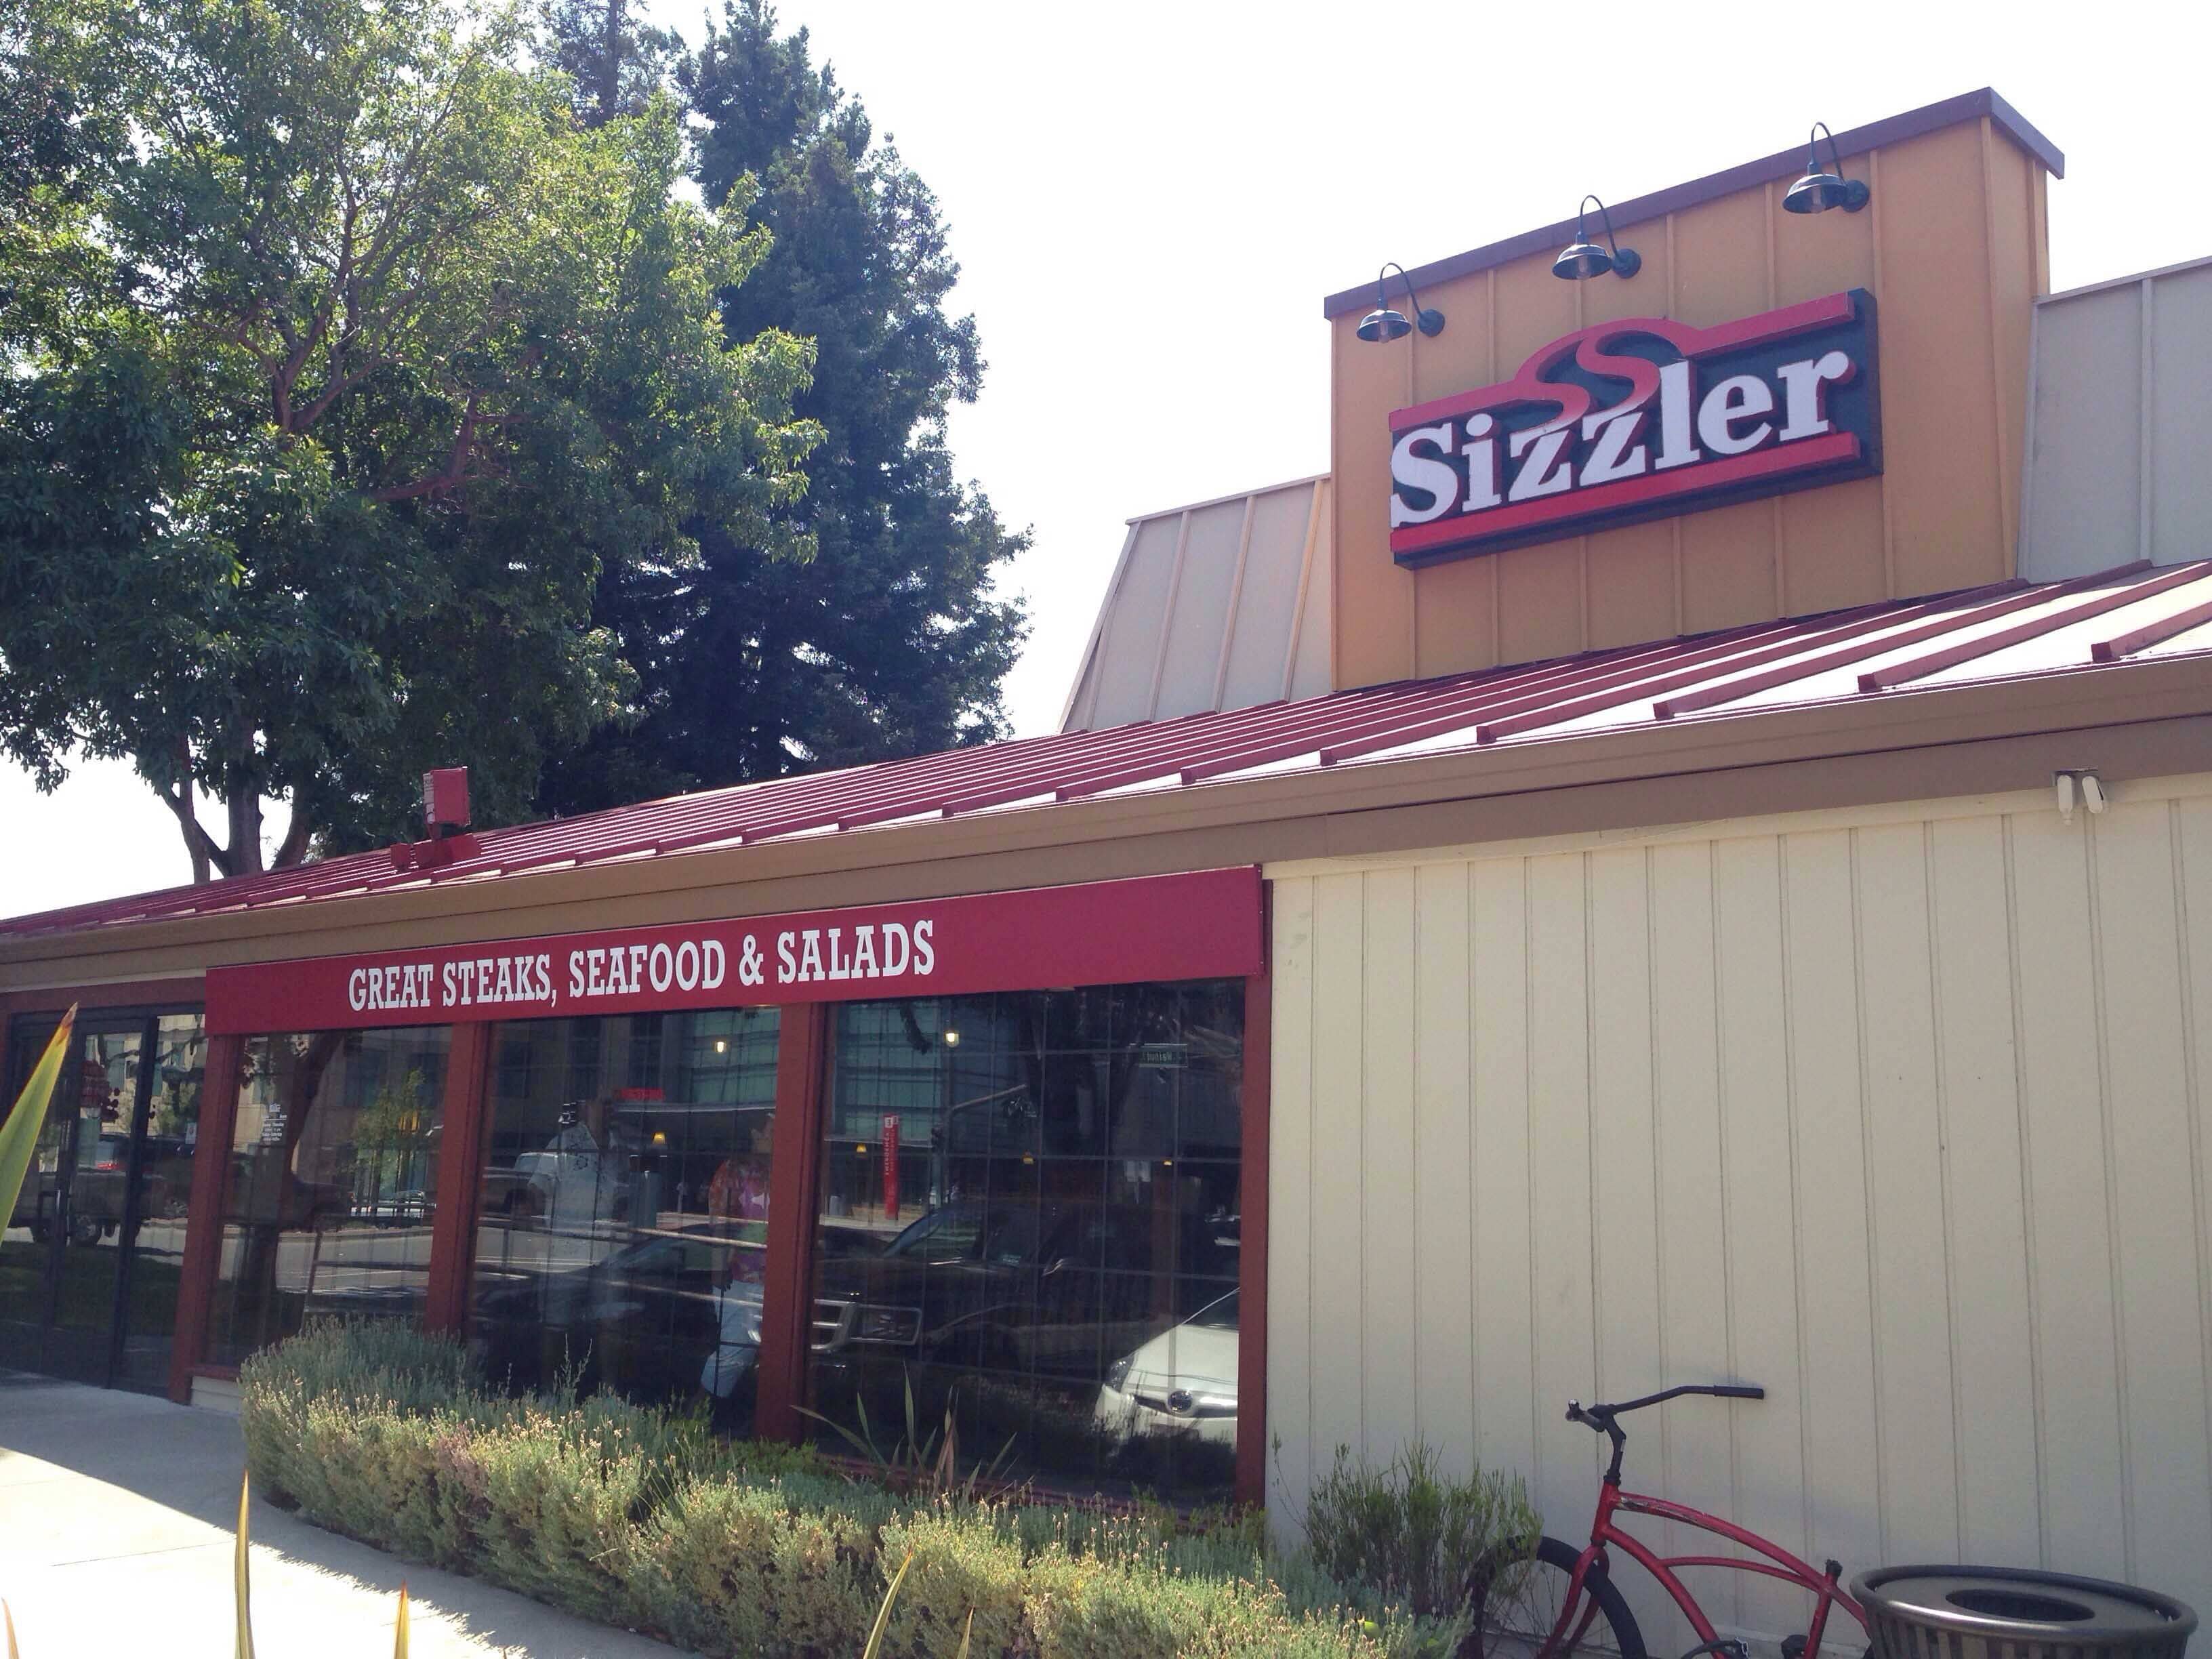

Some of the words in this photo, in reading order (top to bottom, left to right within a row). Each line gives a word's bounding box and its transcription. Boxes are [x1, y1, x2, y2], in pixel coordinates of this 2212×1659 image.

[1390, 350, 1851, 529] Sizzler
[349, 963, 434, 1012] GREAT
[442, 953, 558, 1009] STEAKS,
[569, 939, 726, 998] SEAFOOD
[739, 934, 765, 987] &
[777, 919, 935, 985] SALADS
